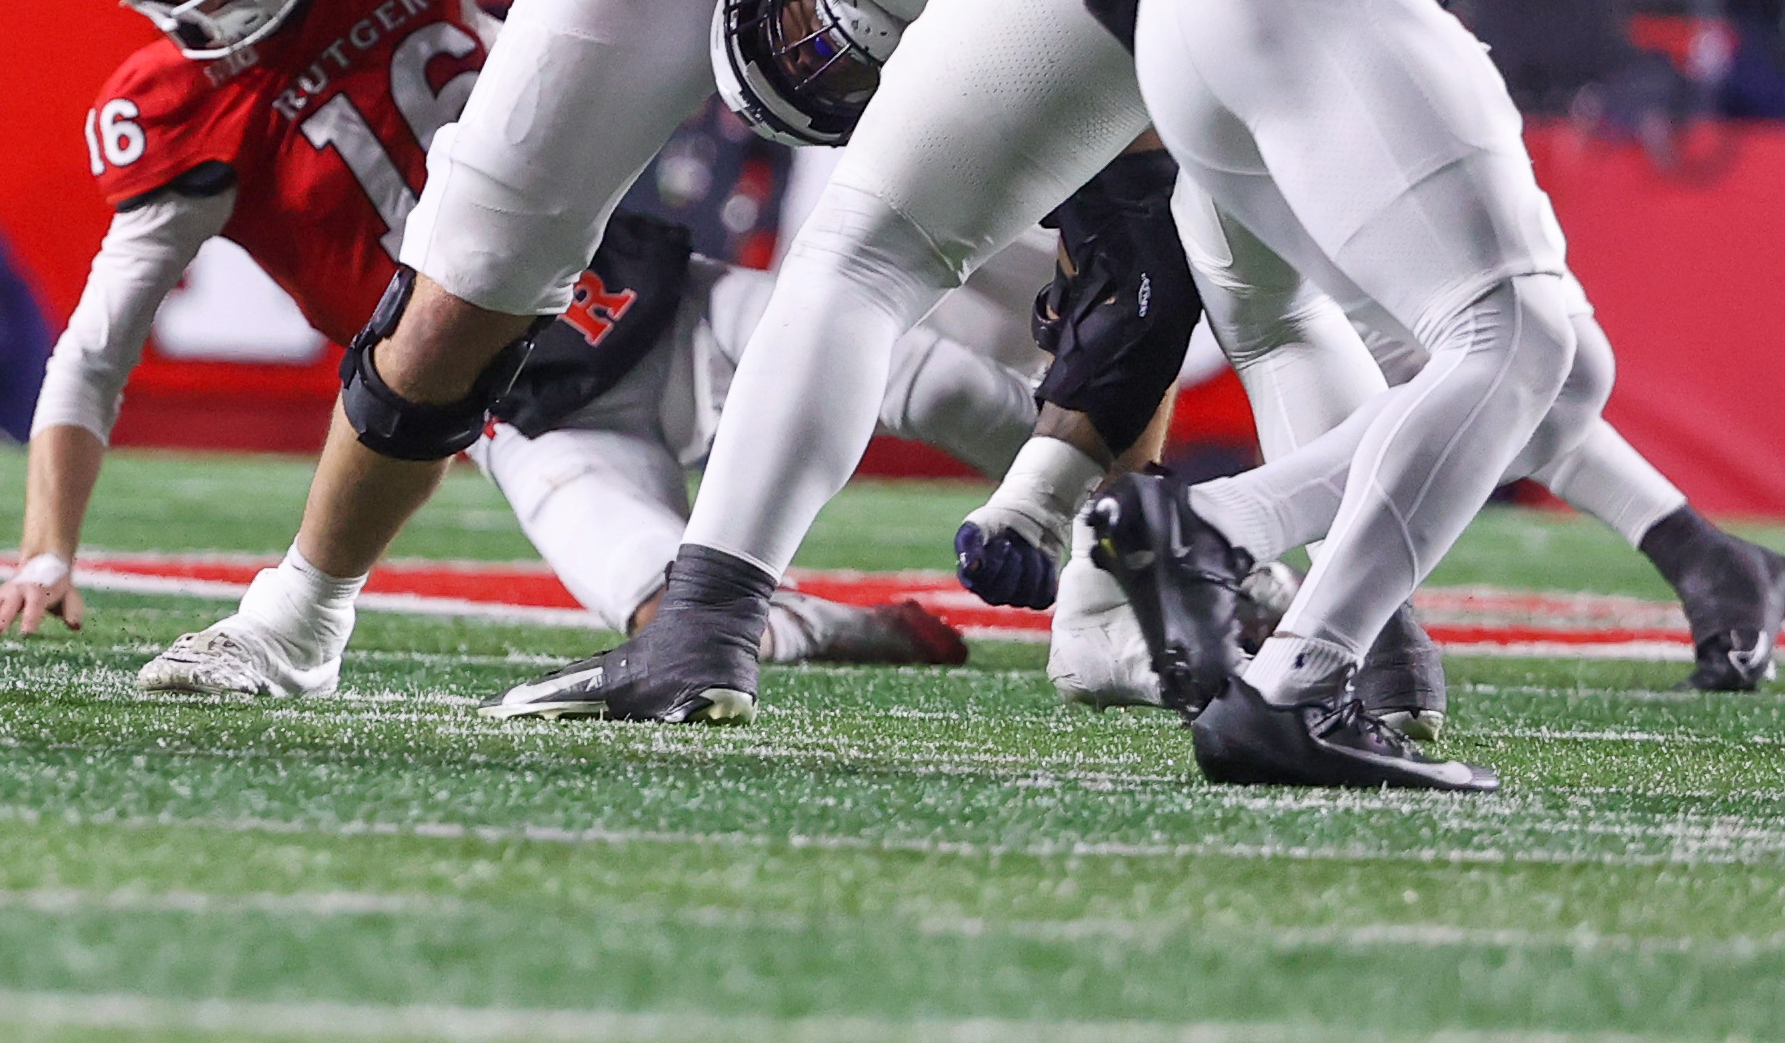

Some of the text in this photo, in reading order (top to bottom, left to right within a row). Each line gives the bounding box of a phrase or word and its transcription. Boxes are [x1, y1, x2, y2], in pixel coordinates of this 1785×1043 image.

[84, 97, 147, 176] 16
[299, 21, 484, 263] 16
[555, 268, 638, 348] R
